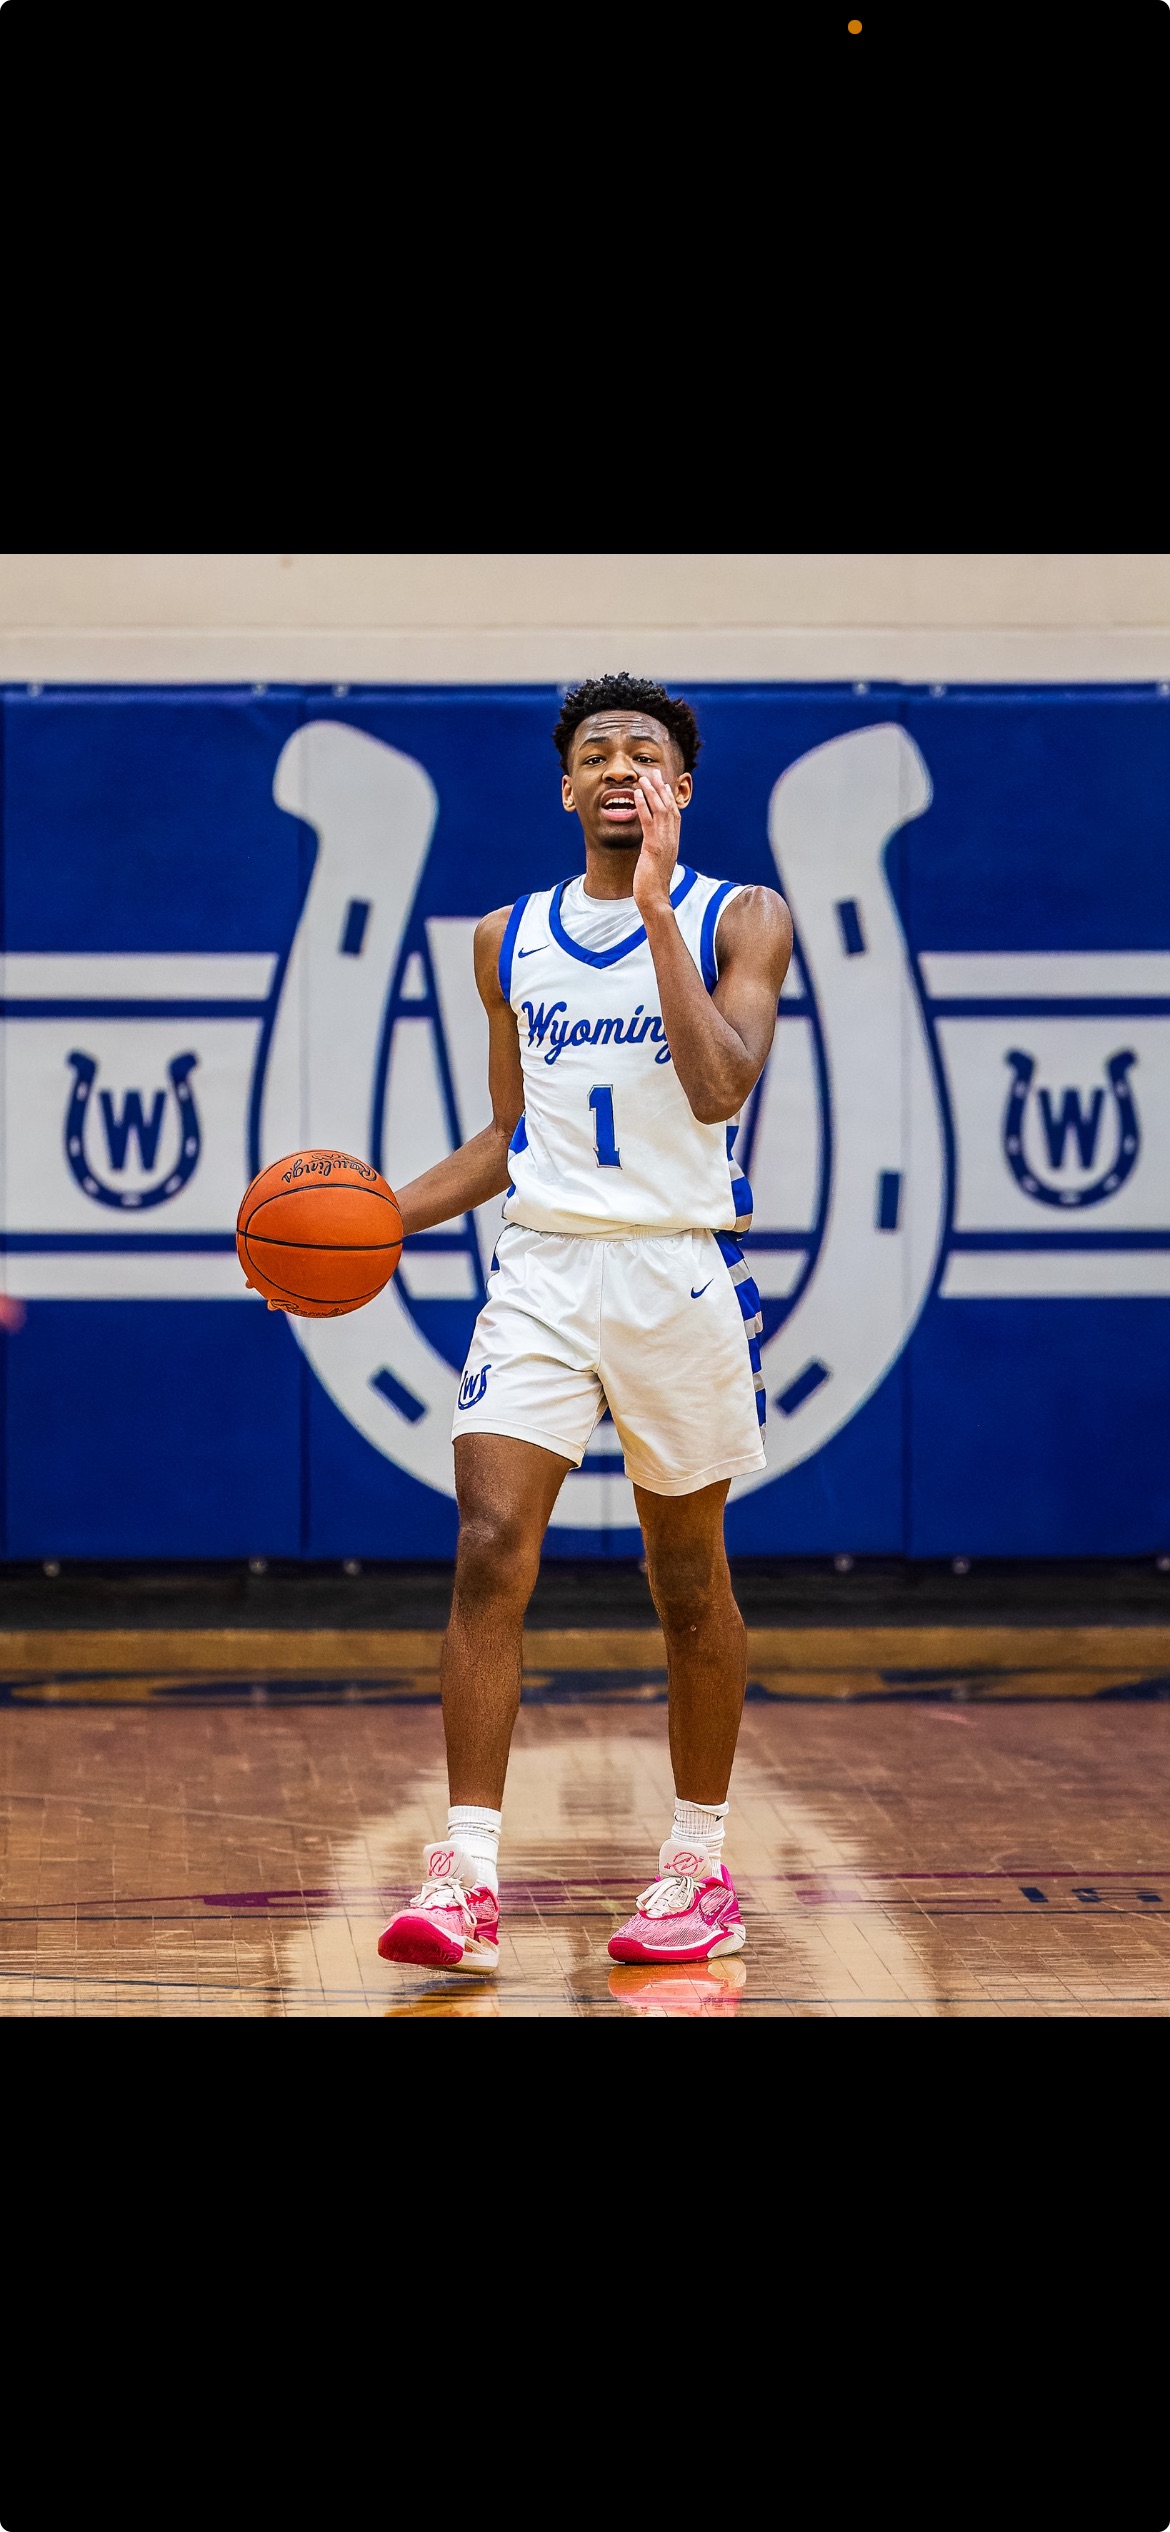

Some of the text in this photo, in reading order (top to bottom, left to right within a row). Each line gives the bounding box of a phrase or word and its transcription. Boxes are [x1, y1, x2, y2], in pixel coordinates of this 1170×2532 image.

[100, 1089, 166, 1172] W
[587, 1084, 623, 1170] 1
[1038, 1088, 1105, 1171] W
[281, 1158, 378, 1183] Rawlings
[463, 1373, 480, 1401] W
